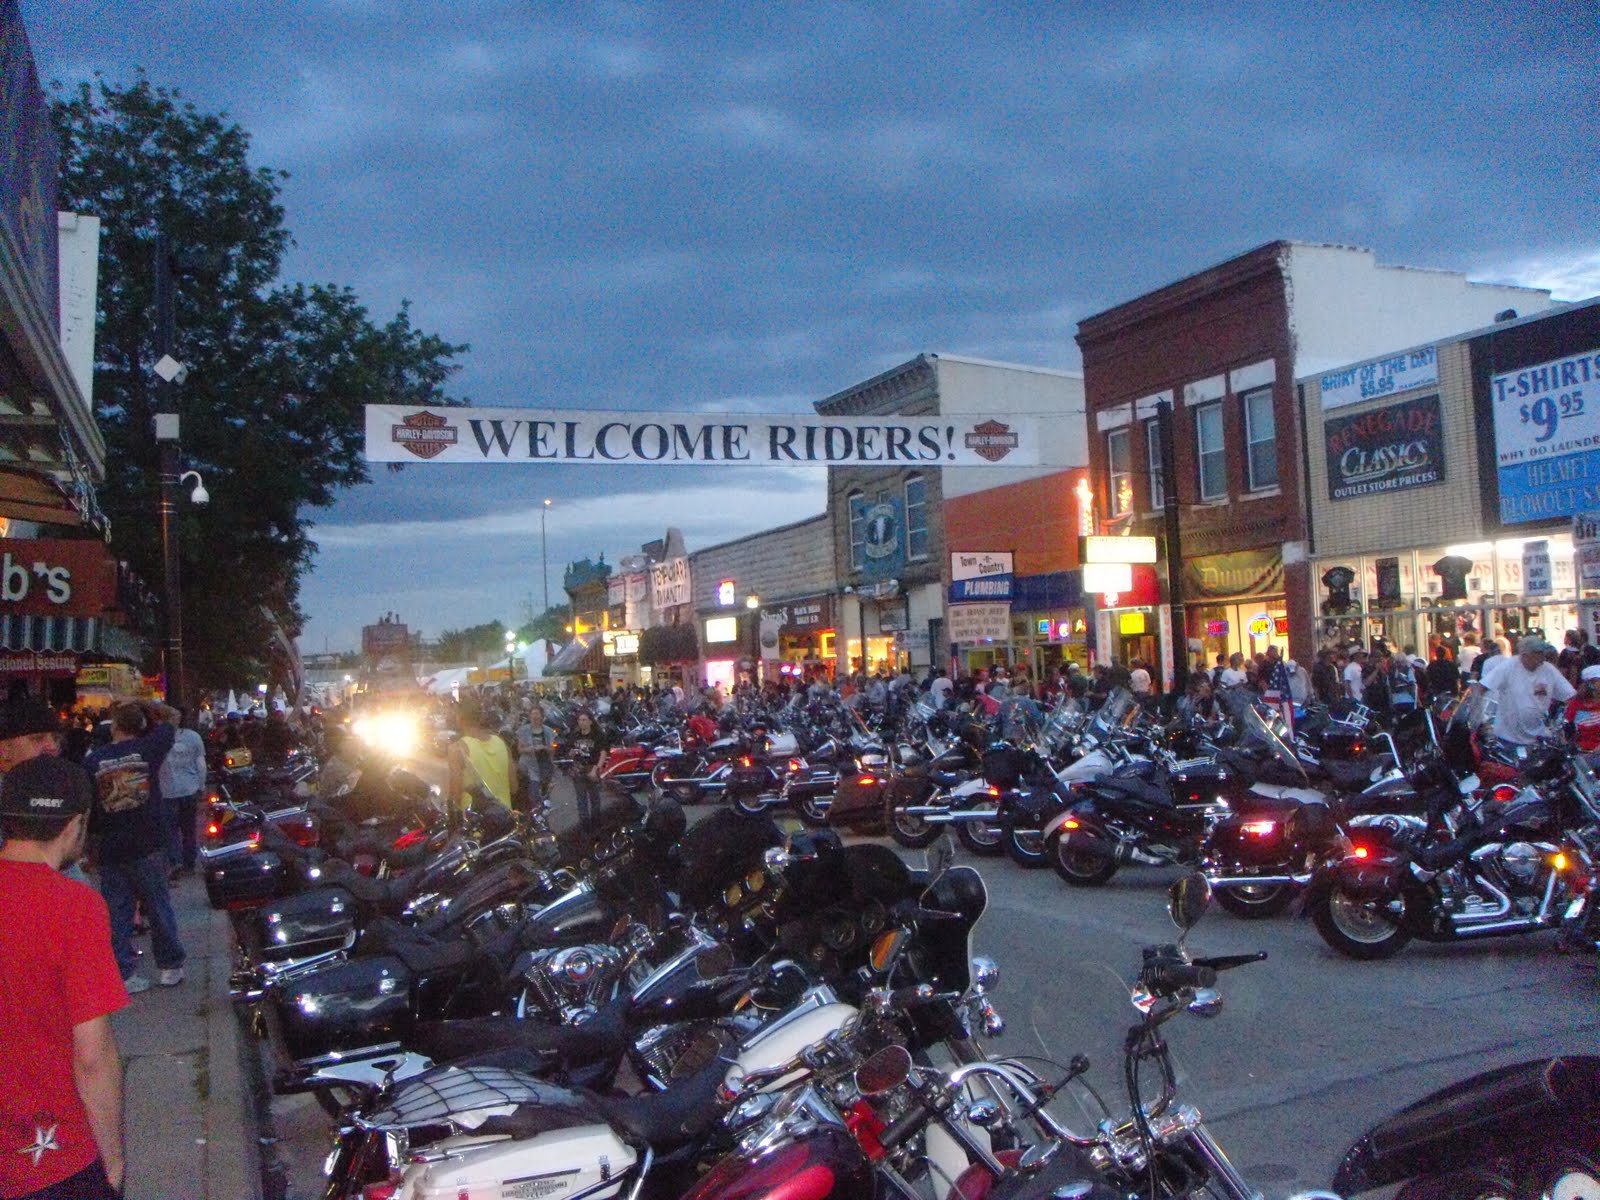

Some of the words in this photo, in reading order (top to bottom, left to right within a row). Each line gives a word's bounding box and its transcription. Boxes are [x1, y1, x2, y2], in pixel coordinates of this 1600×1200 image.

[1322, 368, 1357, 391] SHIRT
[1361, 365, 1377, 381] OF
[1381, 356, 1407, 375] THE
[1411, 346, 1435, 368] DAY
[396, 428, 454, 440] HARLEY-DAVIDSON
[467, 419, 751, 461] WELCOME
[768, 424, 956, 461] RIDERS!
[1341, 439, 1428, 477] CLASSICS
[1500, 449, 1525, 461] WHY
[1530, 446, 1547, 456] DO
[1527, 454, 1589, 487] HELMET
[1335, 484, 1367, 498] OUTLET
[1369, 479, 1398, 492] STORE
[1400, 471, 1437, 486] PRICES!
[960, 556, 977, 567] Town
[979, 562, 1005, 574] Country
[964, 581, 1010, 596] PLUMBING
[1249, 619, 1271, 635] OPEN
